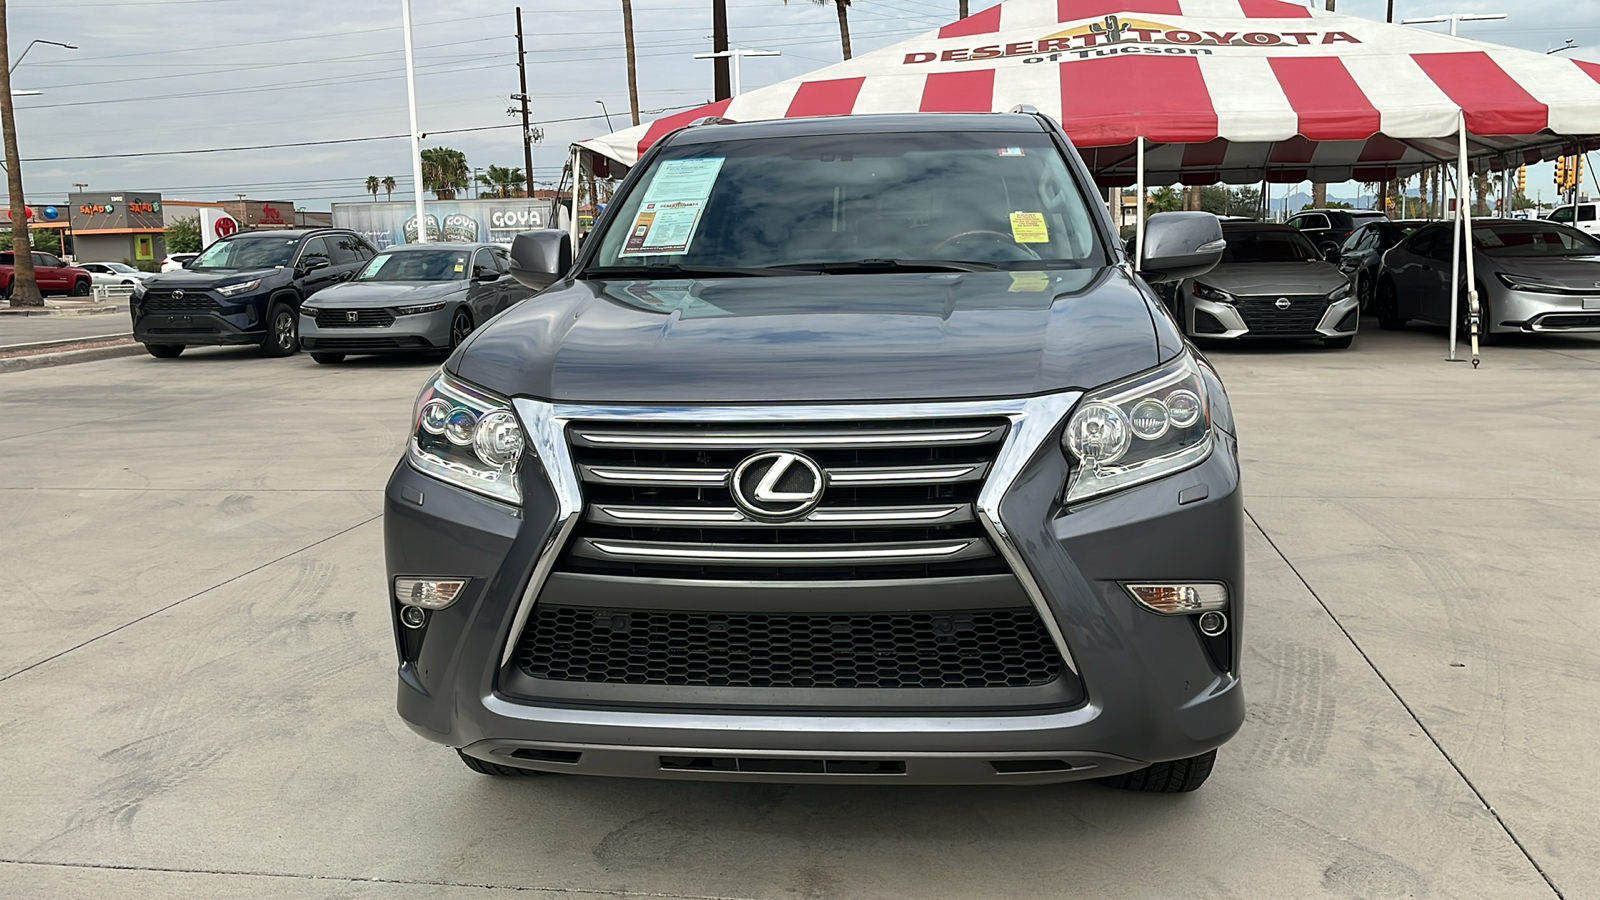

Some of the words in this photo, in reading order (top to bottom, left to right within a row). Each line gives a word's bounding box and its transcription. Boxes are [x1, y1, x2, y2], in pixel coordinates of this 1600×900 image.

[902, 31, 1107, 65] DESERT
[1127, 27, 1363, 45] TOYOTA
[1022, 52, 1062, 64] of
[1070, 46, 1213, 58] Tucson
[447, 216, 475, 231] GOYA
[492, 210, 541, 227] GOYA
